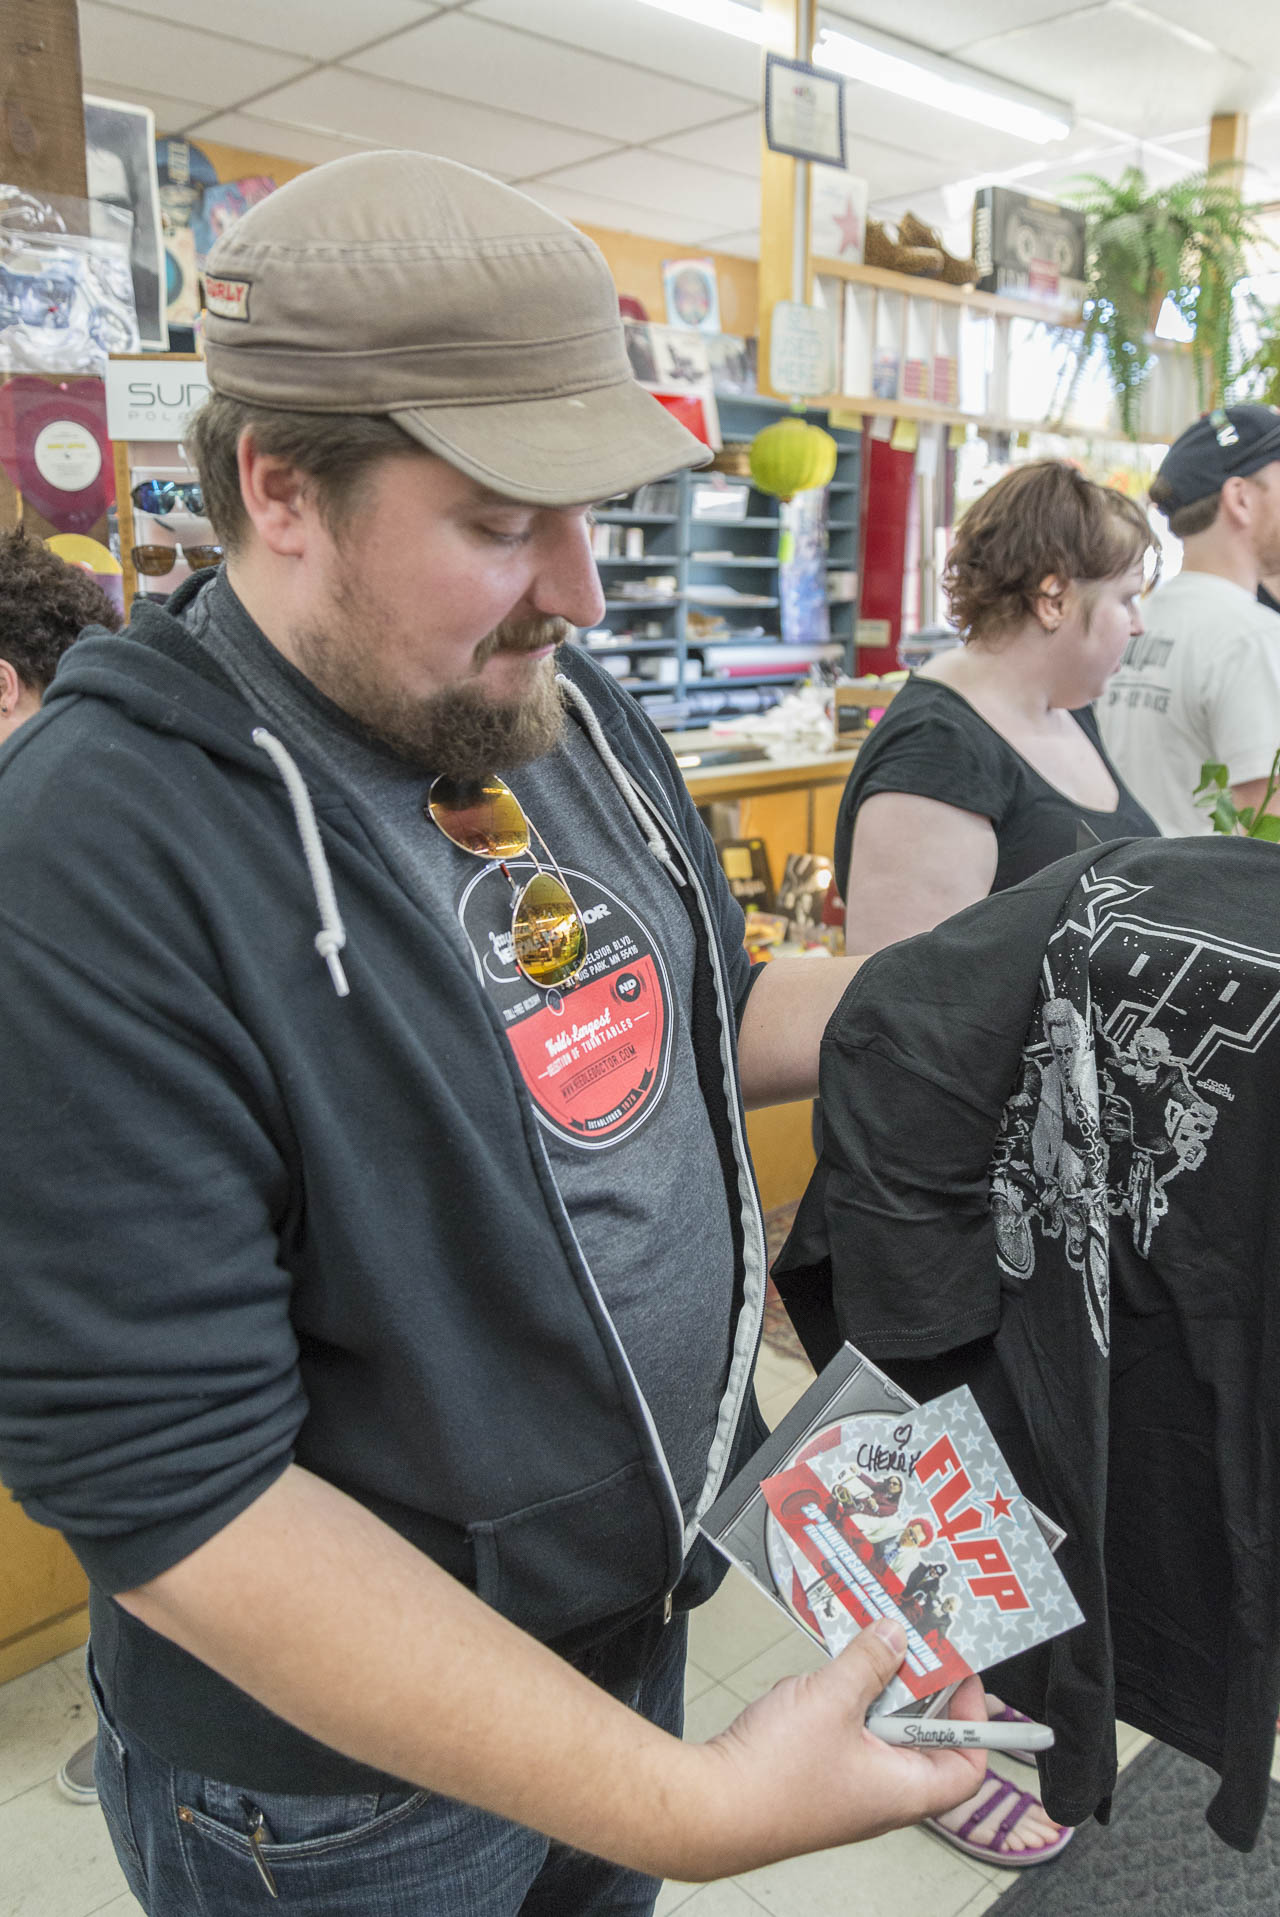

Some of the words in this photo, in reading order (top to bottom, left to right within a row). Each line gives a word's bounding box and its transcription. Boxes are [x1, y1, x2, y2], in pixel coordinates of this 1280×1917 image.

[618, 978, 638, 994] ND
[571, 1007, 611, 1042] Largest
[581, 1017, 633, 1053] TURNTABLES
[857, 1444, 921, 1478] CHERRY
[913, 1433, 1033, 1611] FLIPP
[815, 1519, 877, 1587] ANNIVERSARY
[906, 1627, 943, 1672] EDITION
[901, 1724, 959, 1746] Sharpie
